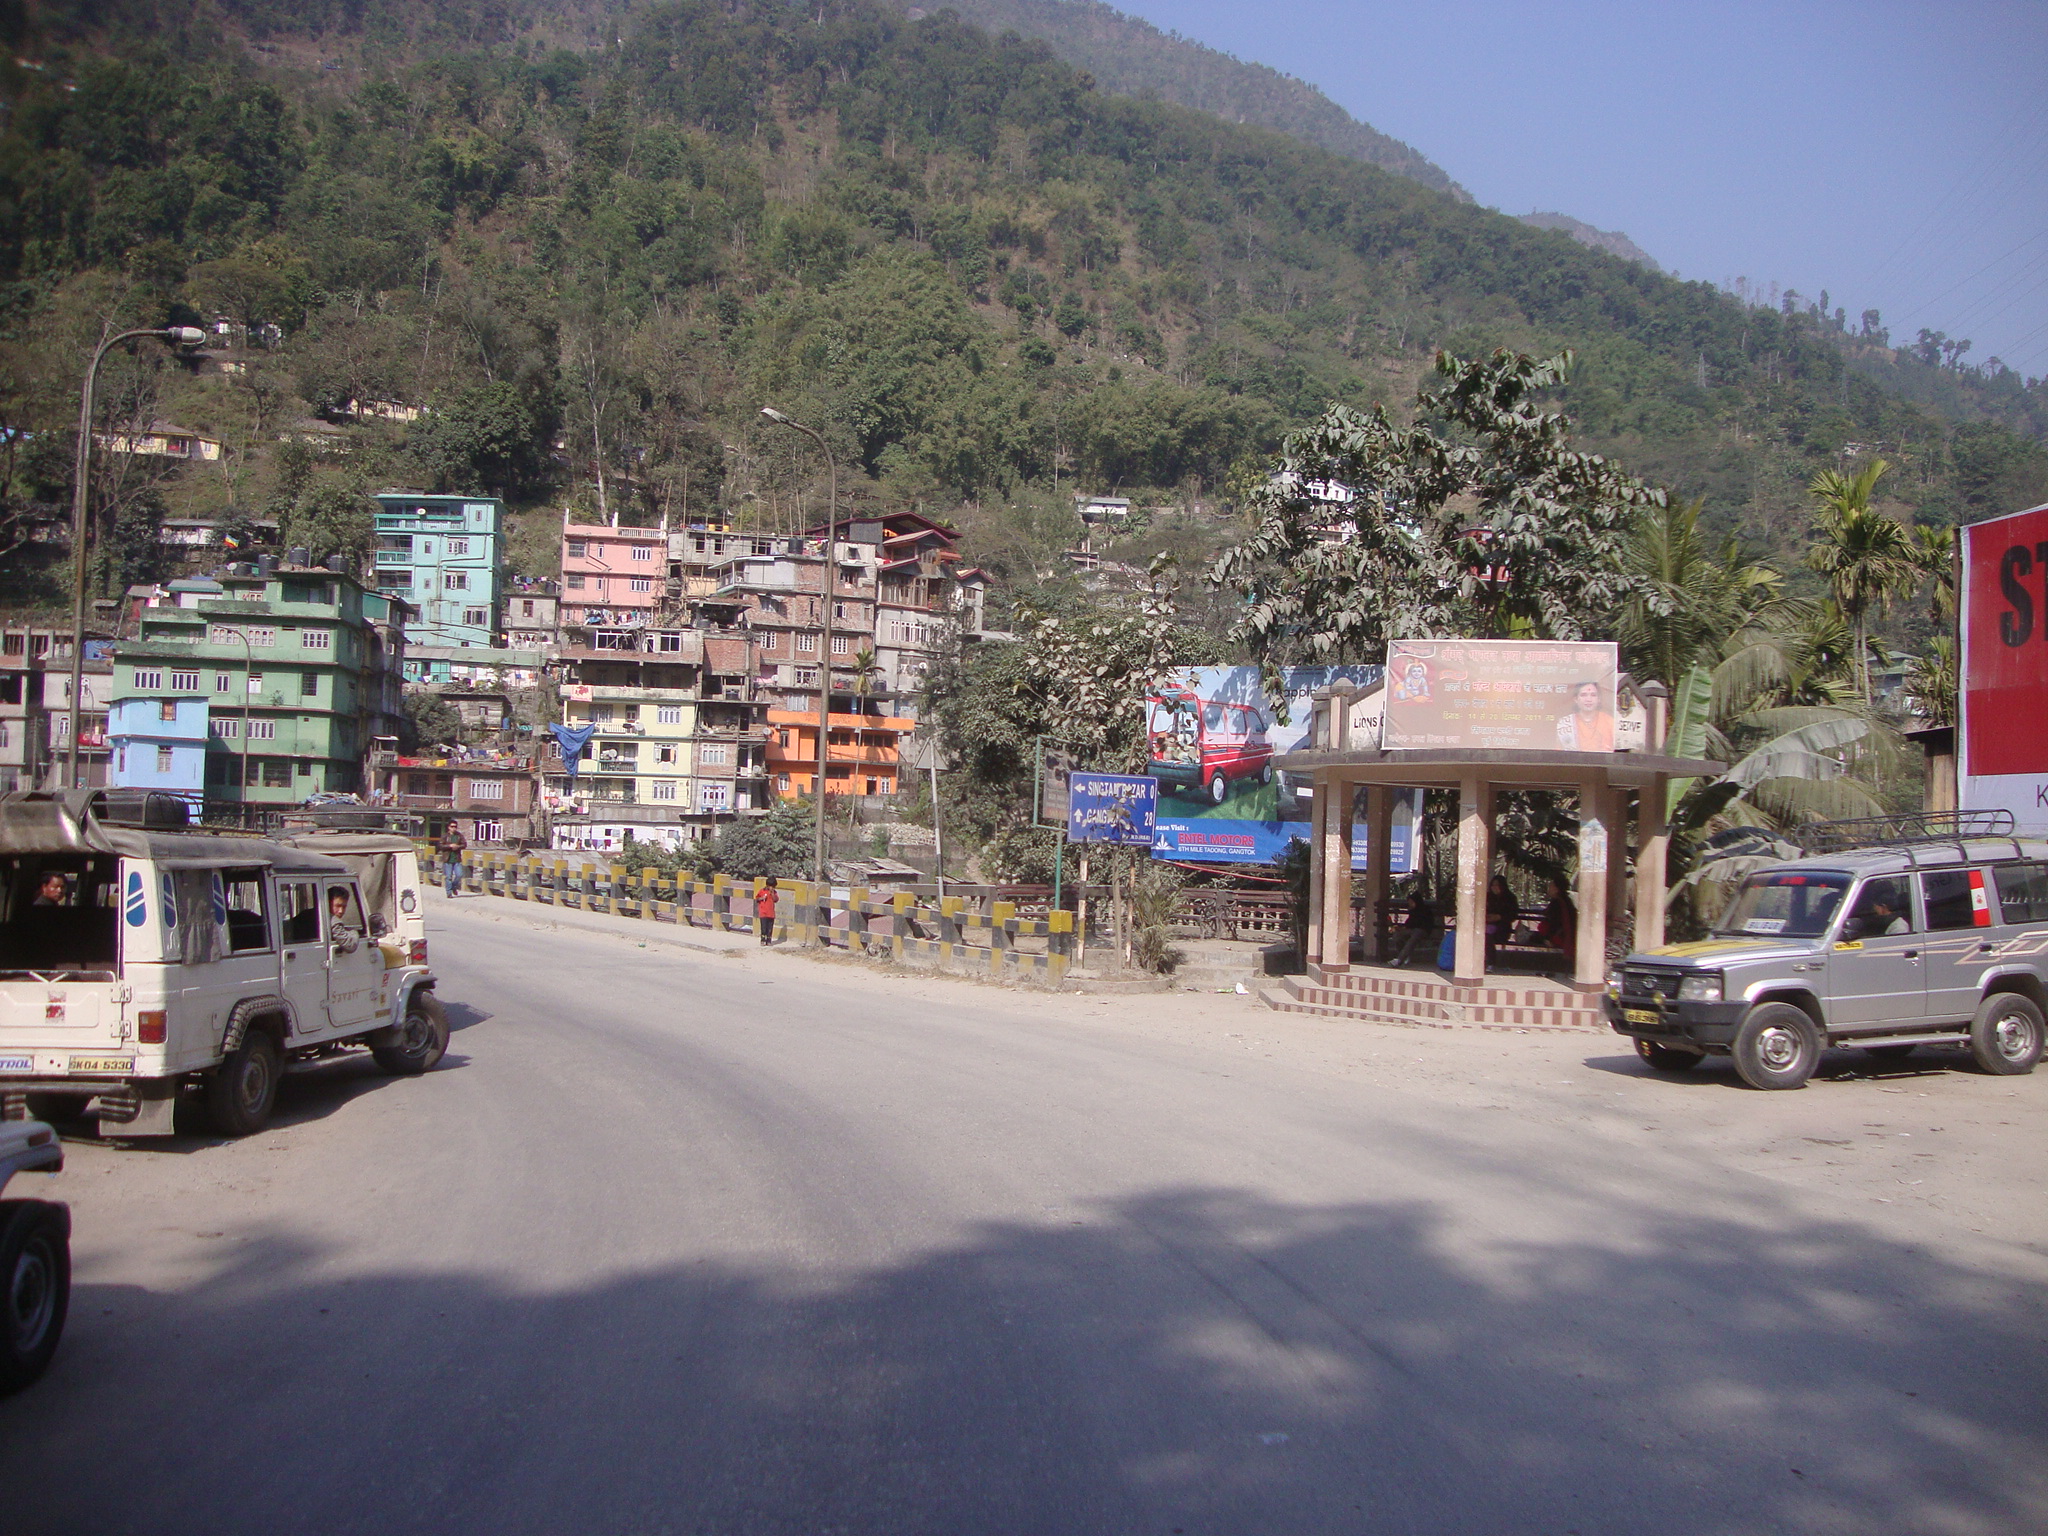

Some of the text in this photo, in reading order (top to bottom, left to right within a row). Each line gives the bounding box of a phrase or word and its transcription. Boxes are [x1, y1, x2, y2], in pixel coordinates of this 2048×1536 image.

[1121, 783, 1146, 799] BZAR
[1144, 811, 1153, 826] 28
[1178, 833, 1255, 846] ENTEL MOTORS
[0, 1059, 31, 1069] TROL
[102, 1060, 133, 1070] 5330
